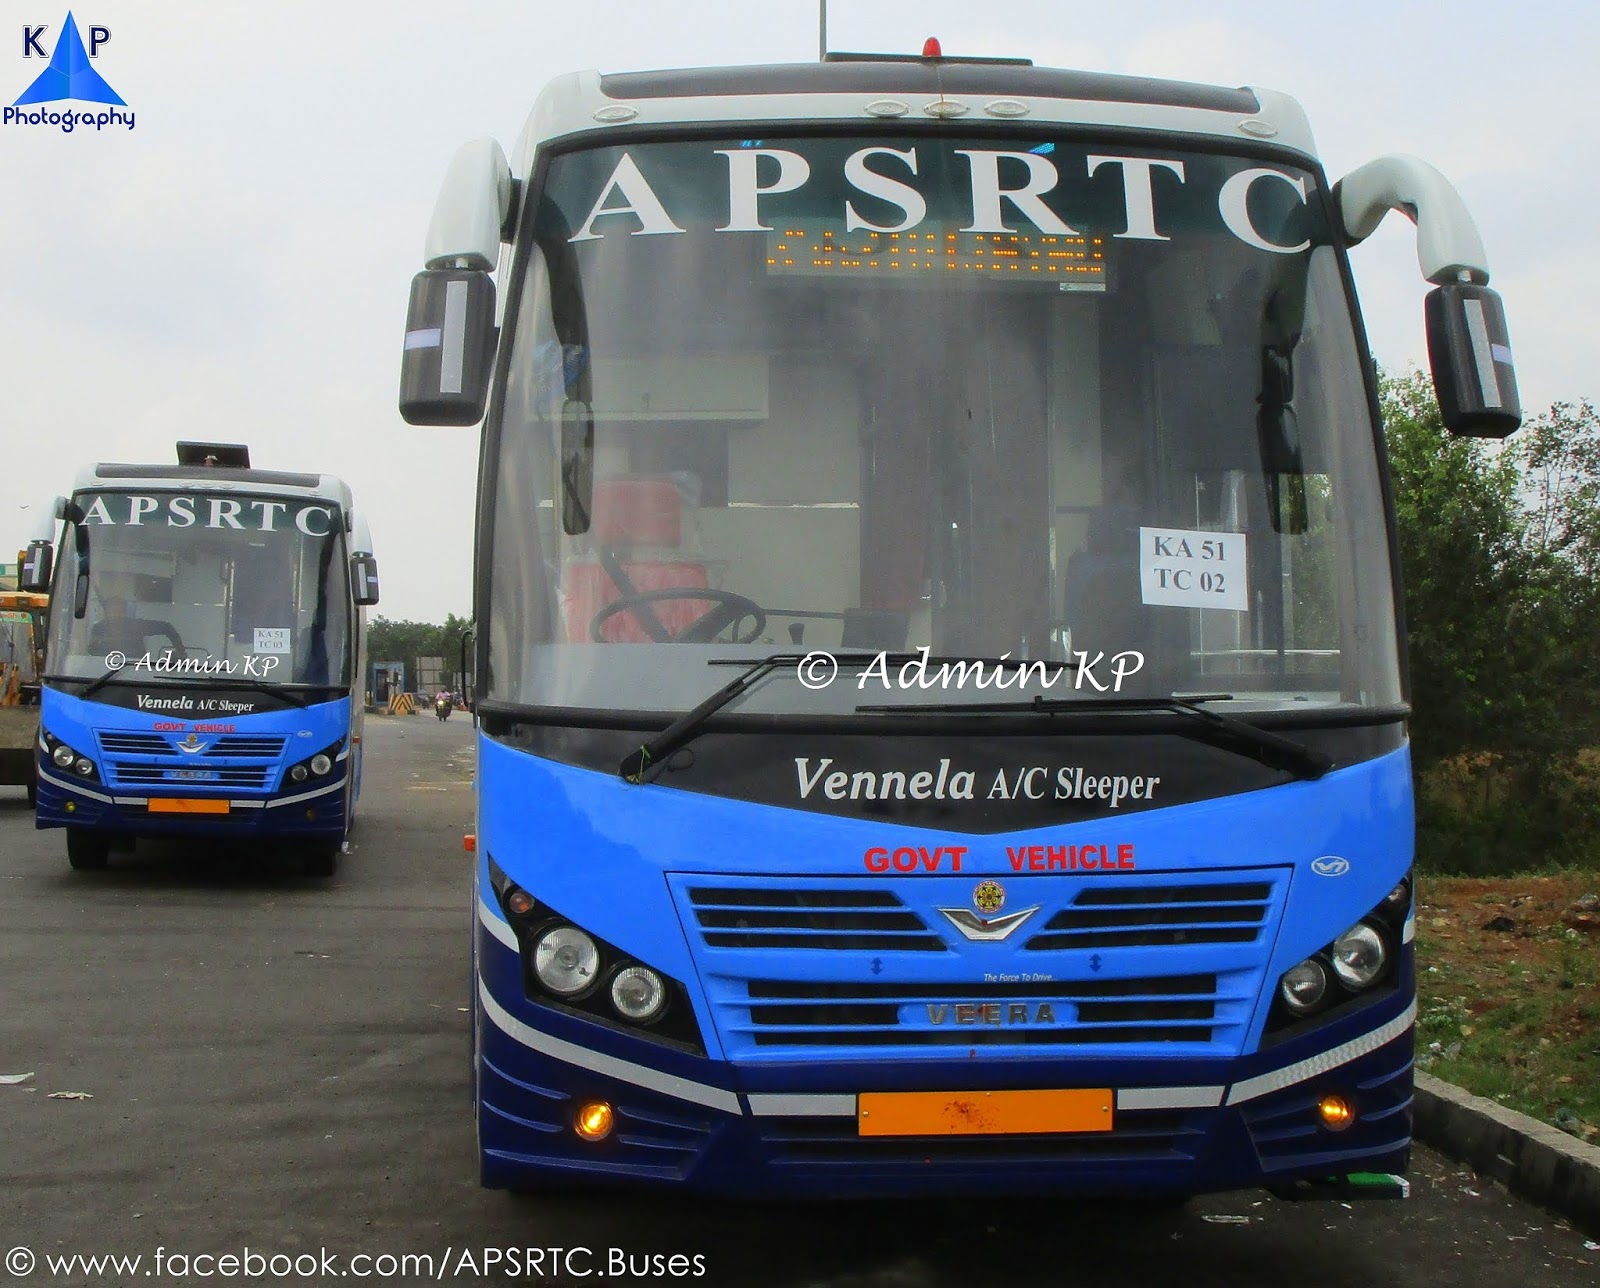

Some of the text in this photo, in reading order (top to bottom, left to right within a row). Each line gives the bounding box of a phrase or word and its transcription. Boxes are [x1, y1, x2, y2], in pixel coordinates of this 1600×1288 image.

[566, 146, 1314, 254] APSRTC
[78, 495, 333, 537] APSRTC
[1153, 536, 1225, 561] KA 51
[1153, 568, 1226, 593] TC 02
[258, 630, 284, 639] KA 51
[258, 640, 283, 649] TC 03
[137, 694, 255, 714] Vennela A/C Sleeper
[154, 723, 236, 733] GOVT VEHICLE
[794, 757, 1161, 808] Vennela A/C Sleeper
[864, 844, 1136, 873] GOVT VEHICLE
[984, 973, 998, 982] The
[999, 973, 1020, 982] Force
[1021, 973, 1031, 982] To
[926, 1003, 1056, 1025] VEERA
